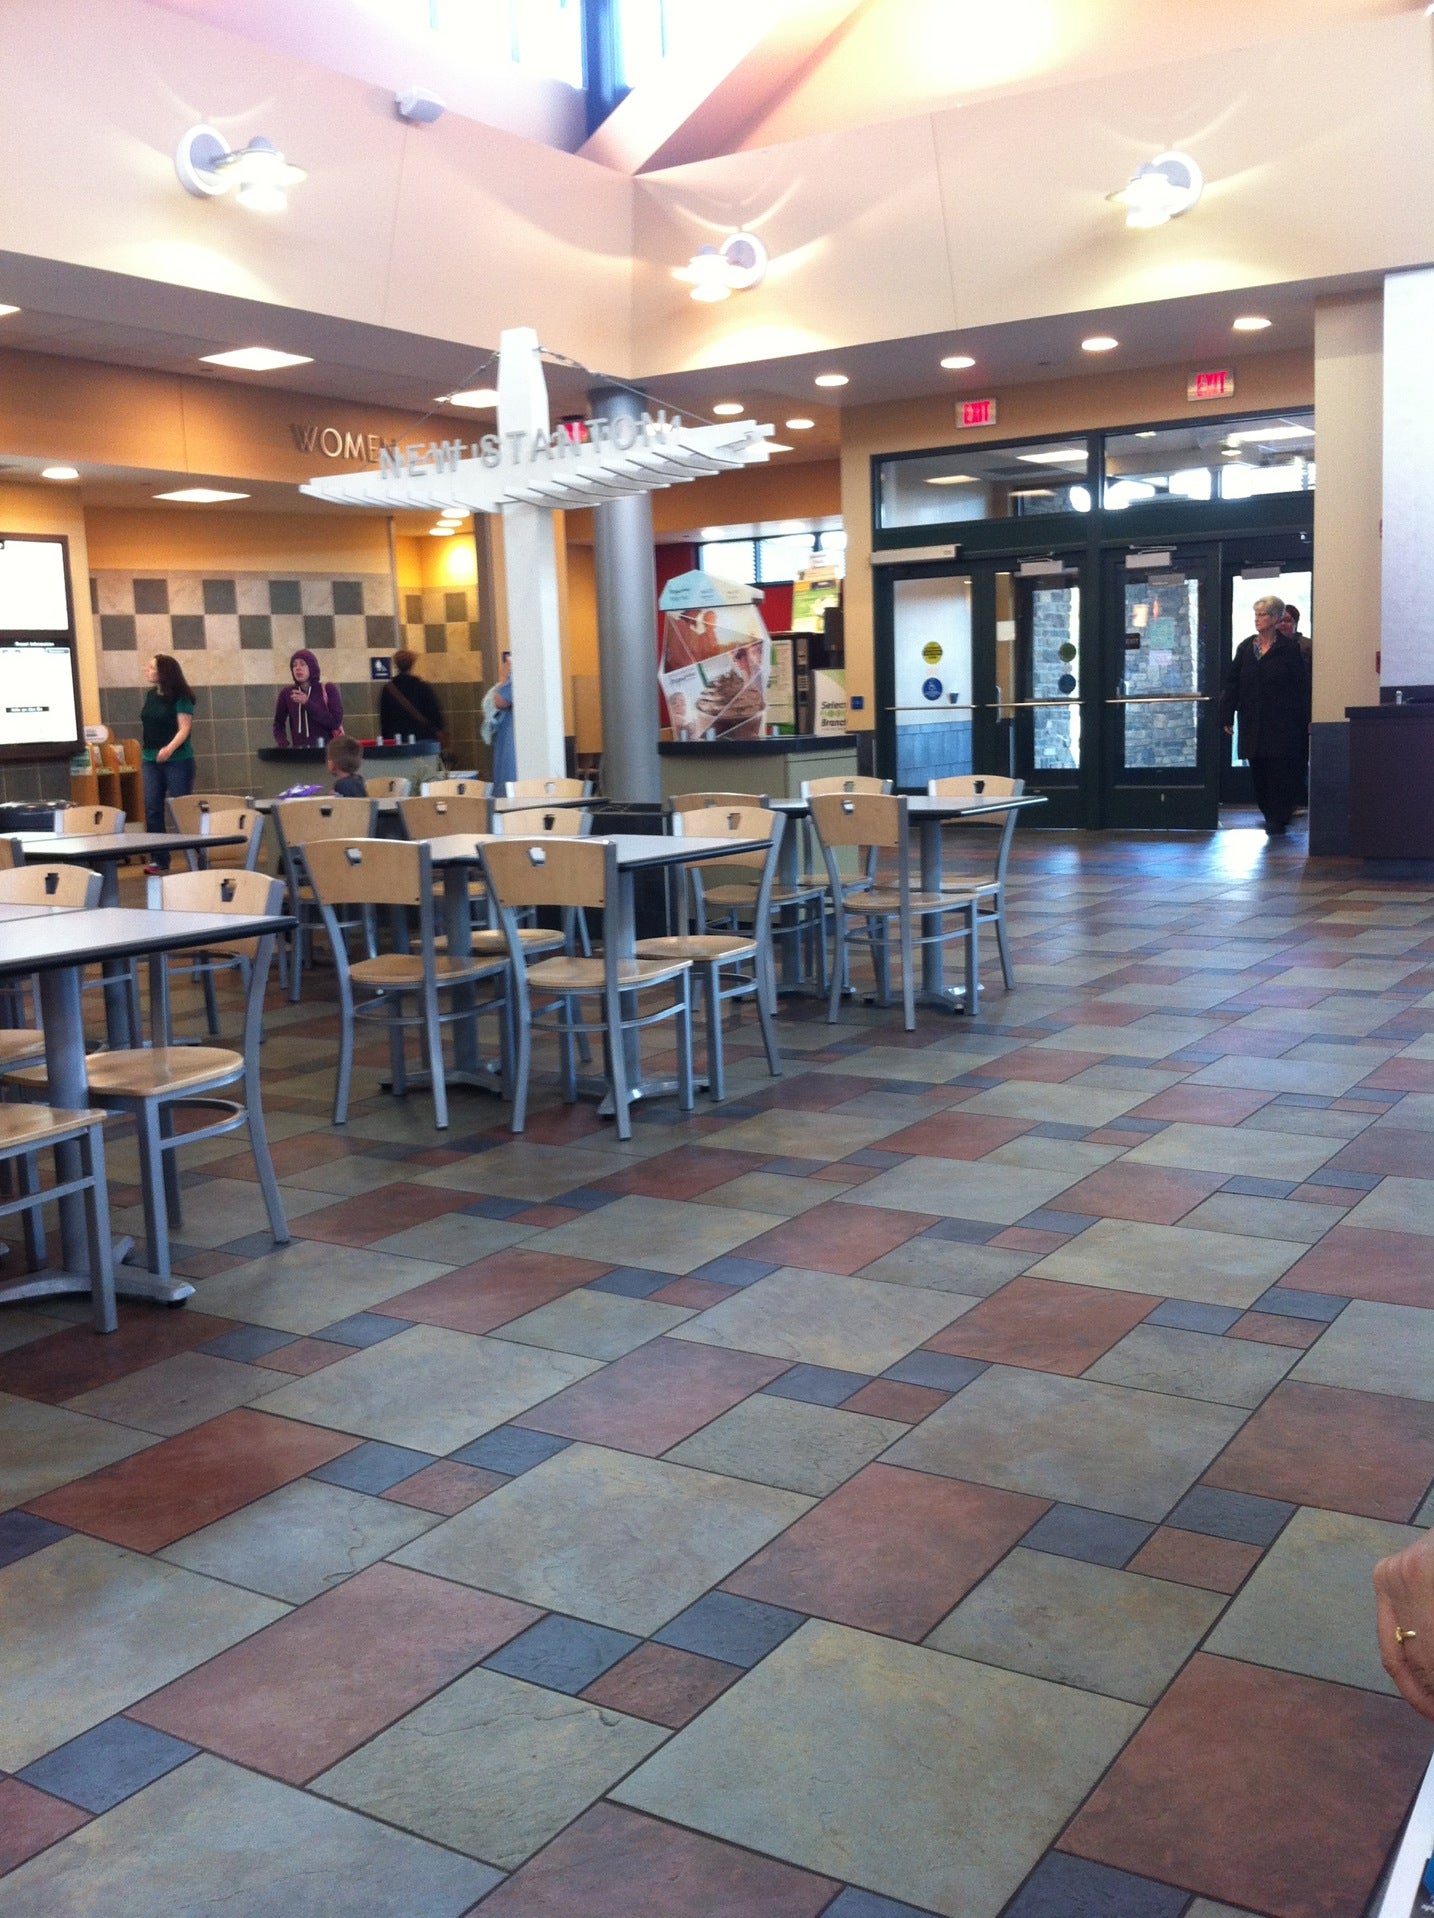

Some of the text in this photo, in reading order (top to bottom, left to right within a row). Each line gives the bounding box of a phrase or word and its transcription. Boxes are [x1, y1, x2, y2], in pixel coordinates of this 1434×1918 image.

[1196, 371, 1227, 397] EXIT
[963, 401, 990, 425] EXIT
[380, 409, 669, 479] NEW STANTON
